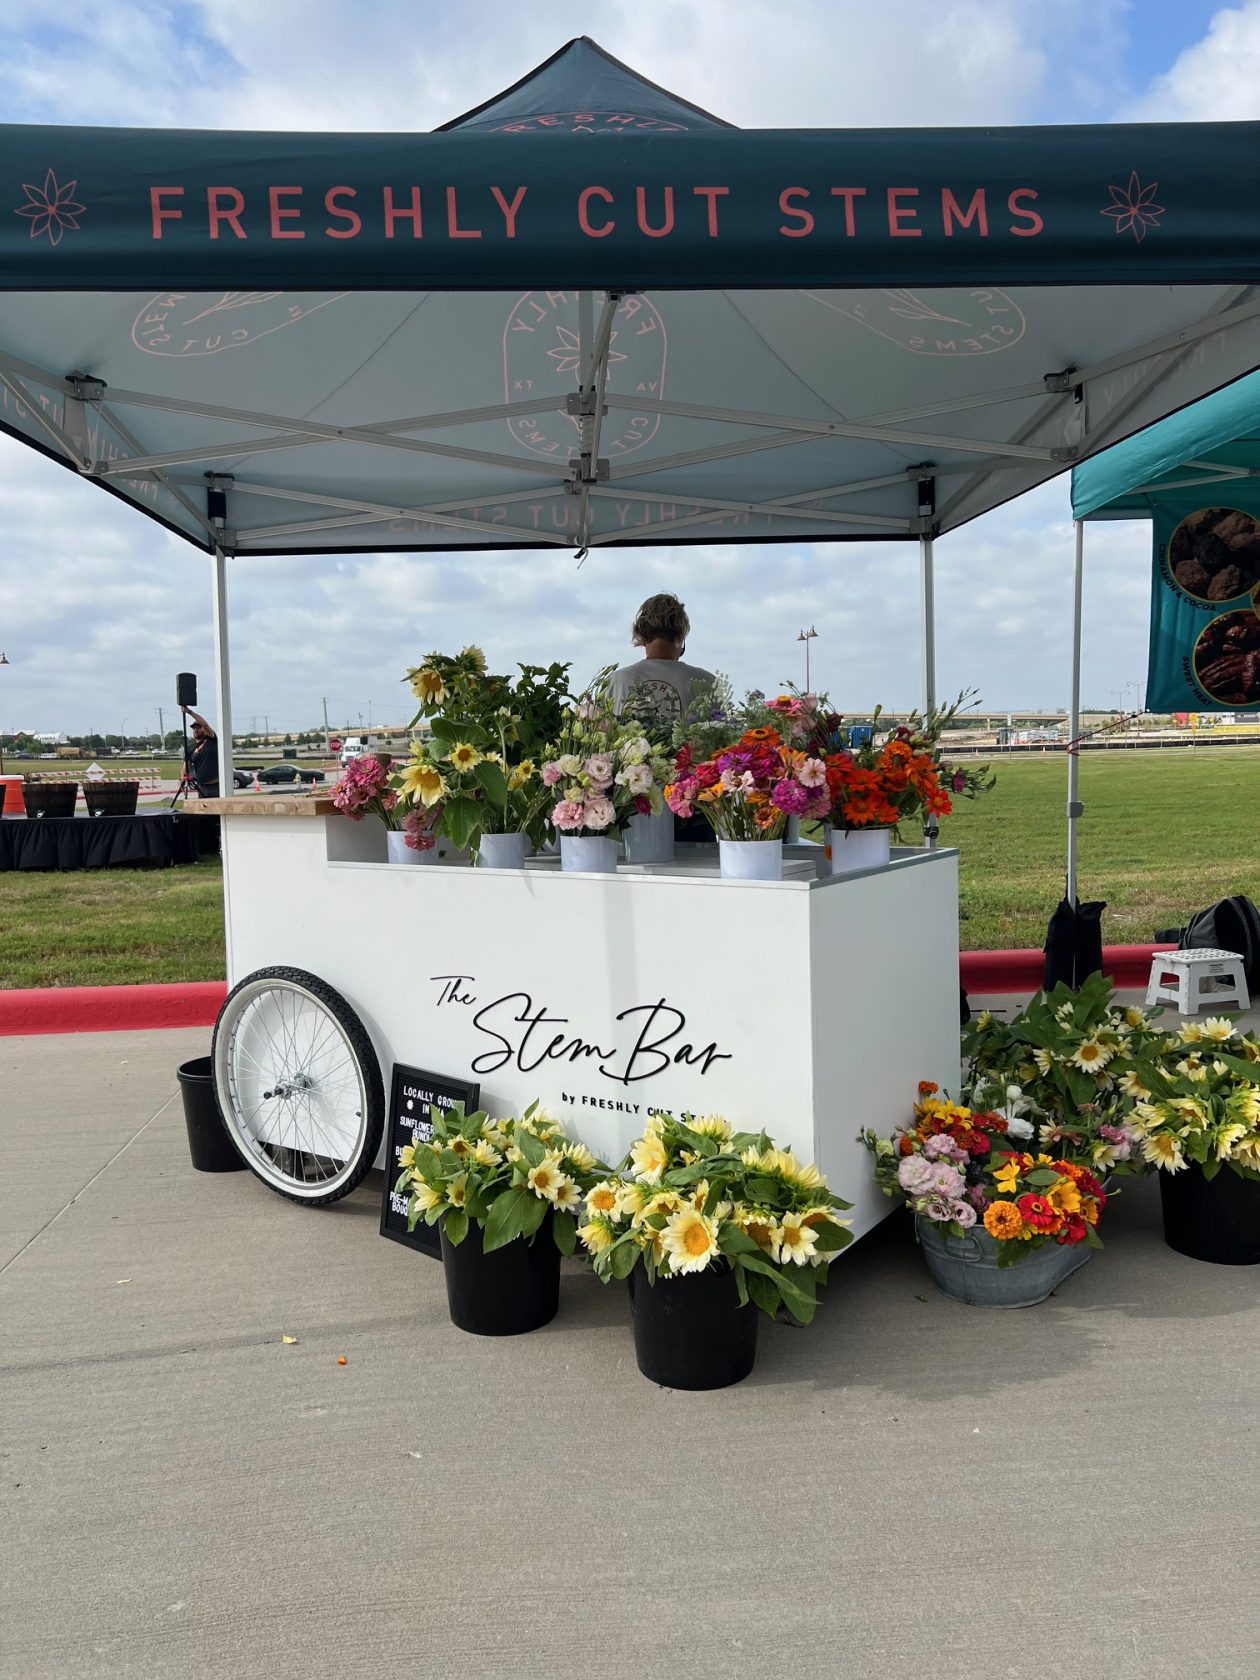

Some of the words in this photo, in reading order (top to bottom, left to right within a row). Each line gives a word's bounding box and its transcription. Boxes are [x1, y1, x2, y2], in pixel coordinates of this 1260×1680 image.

[150, 186, 528, 240] FRESHLY
[577, 186, 730, 239] CUT
[778, 188, 1045, 238] STEMS
[1159, 543, 1178, 592] CINNAMON
[1183, 596, 1217, 612] COCOA
[1182, 655, 1196, 688] SWEET
[1192, 687, 1214, 706] HEAT
[430, 975, 477, 1006] The
[470, 992, 617, 1074] Stem
[599, 997, 733, 1086] Bar
[403, 1085, 434, 1102] LOCALLY
[561, 1092, 575, 1105] by
[582, 1095, 640, 1114] FRESHLY
